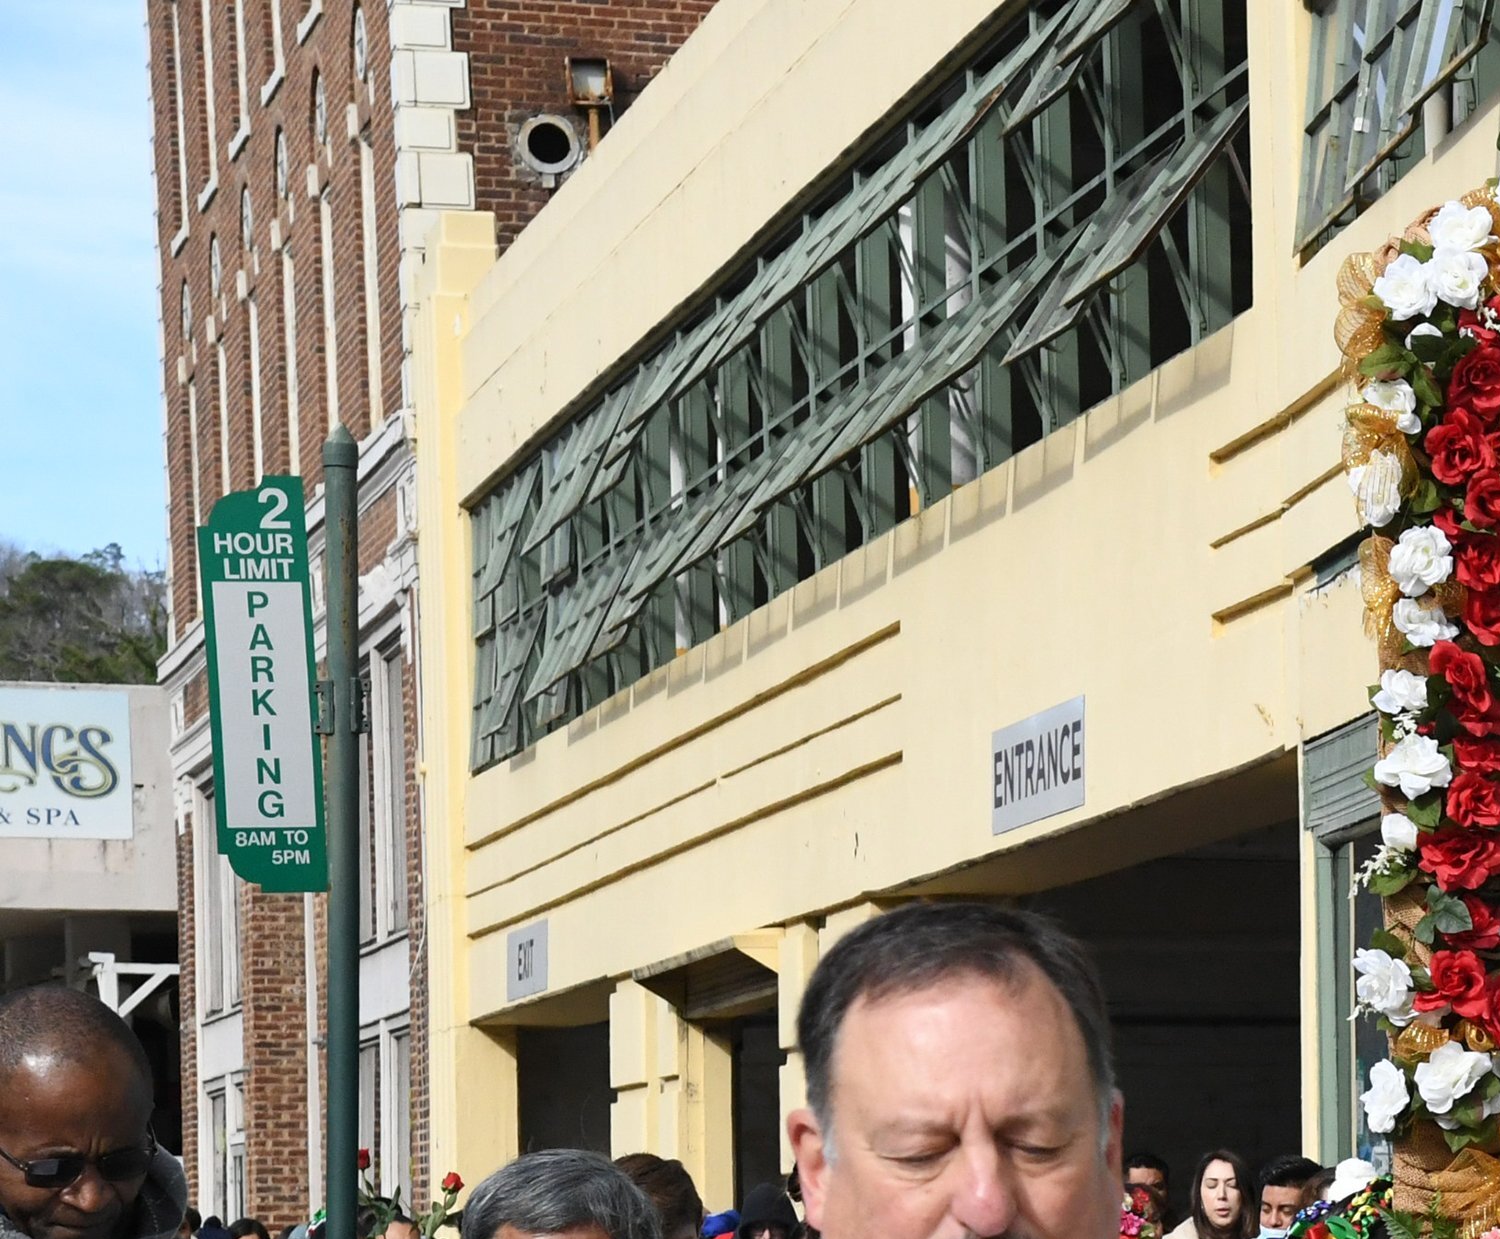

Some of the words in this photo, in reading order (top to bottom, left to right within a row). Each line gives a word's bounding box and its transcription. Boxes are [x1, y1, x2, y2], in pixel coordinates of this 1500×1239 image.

[258, 487, 291, 529] 2
[213, 532, 294, 555] HOUR
[223, 558, 295, 580] LIMIT
[247, 591, 285, 818] PARKING
[994, 719, 1082, 809] ENTRANCE
[26, 807, 80, 826] SPA
[235, 831, 276, 847] 8AM
[283, 829, 309, 845] TO
[271, 849, 311, 865] 5PM
[518, 938, 534, 981] EXIT
